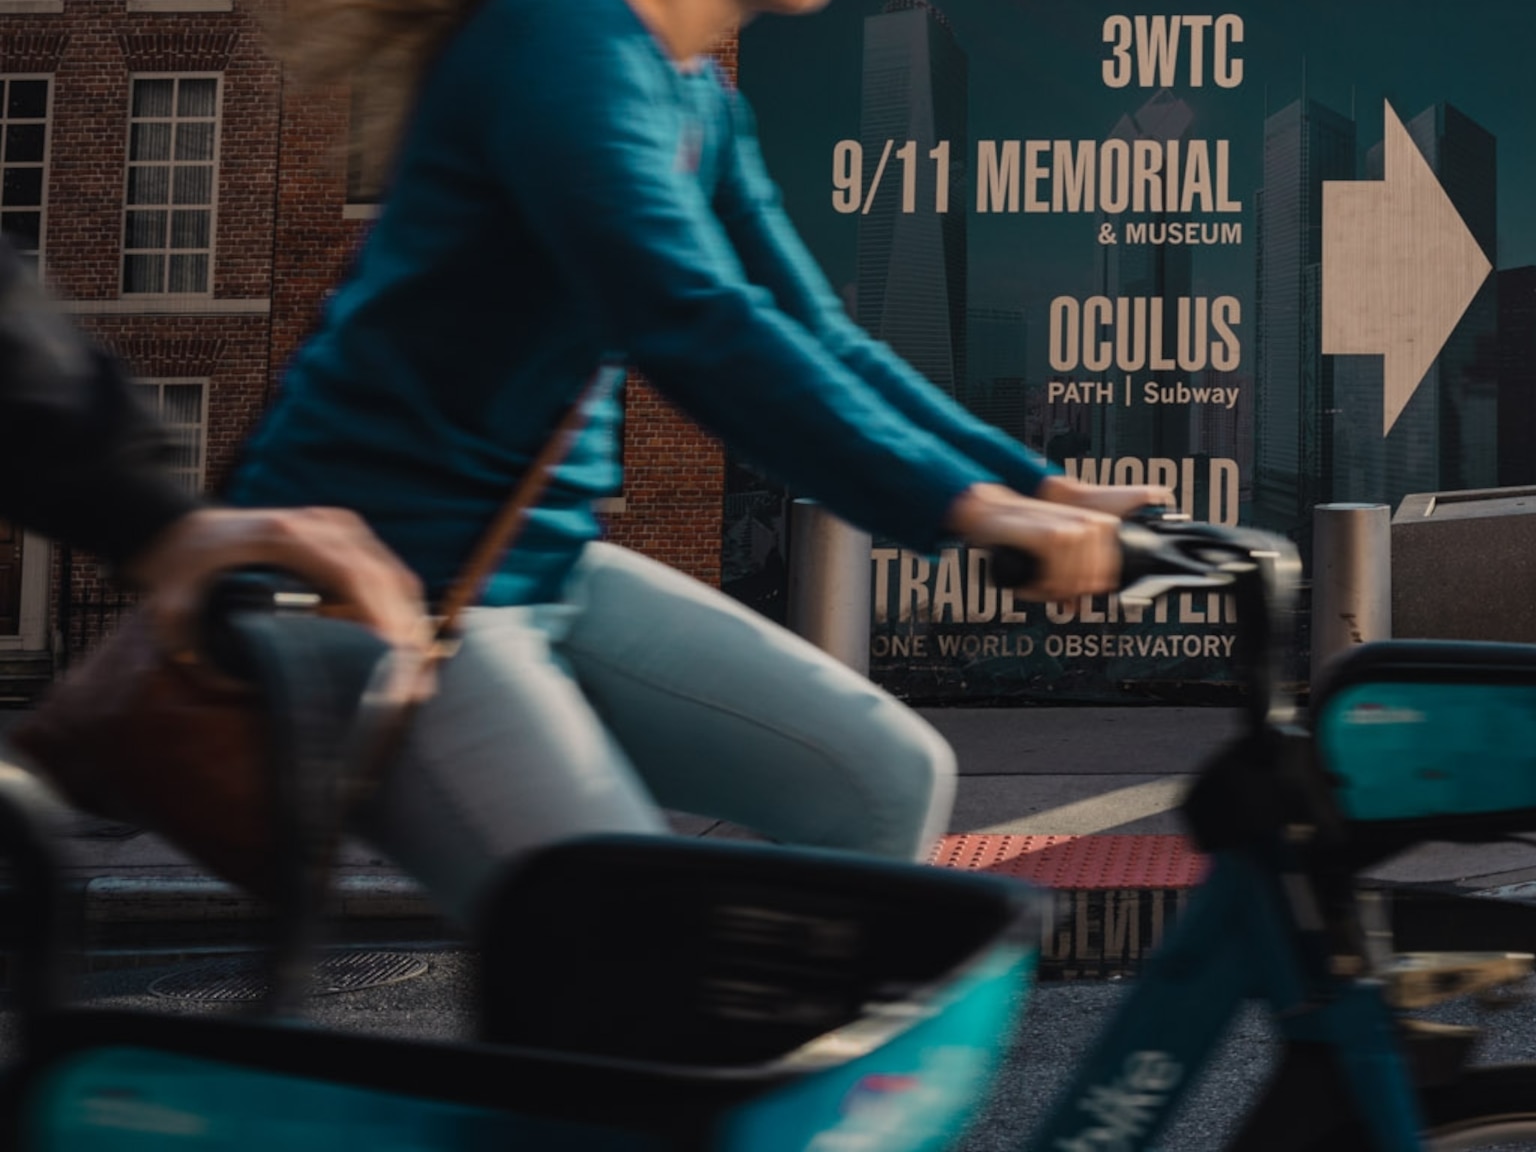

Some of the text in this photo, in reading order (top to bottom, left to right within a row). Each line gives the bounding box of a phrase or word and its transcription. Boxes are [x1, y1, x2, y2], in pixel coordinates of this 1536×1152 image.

[1101, 14, 1244, 88] 3WTC
[832, 138, 1242, 215] 9/11 MEMORIAL
[1097, 223, 1242, 245] & MUSEUM
[1049, 296, 1241, 373] OCULUS
[1048, 381, 1114, 404] PATH
[1144, 381, 1240, 410] Subway
[871, 549, 1027, 624] TRAD
[871, 635, 1236, 658] ONE WORLD OBSERVATORY
